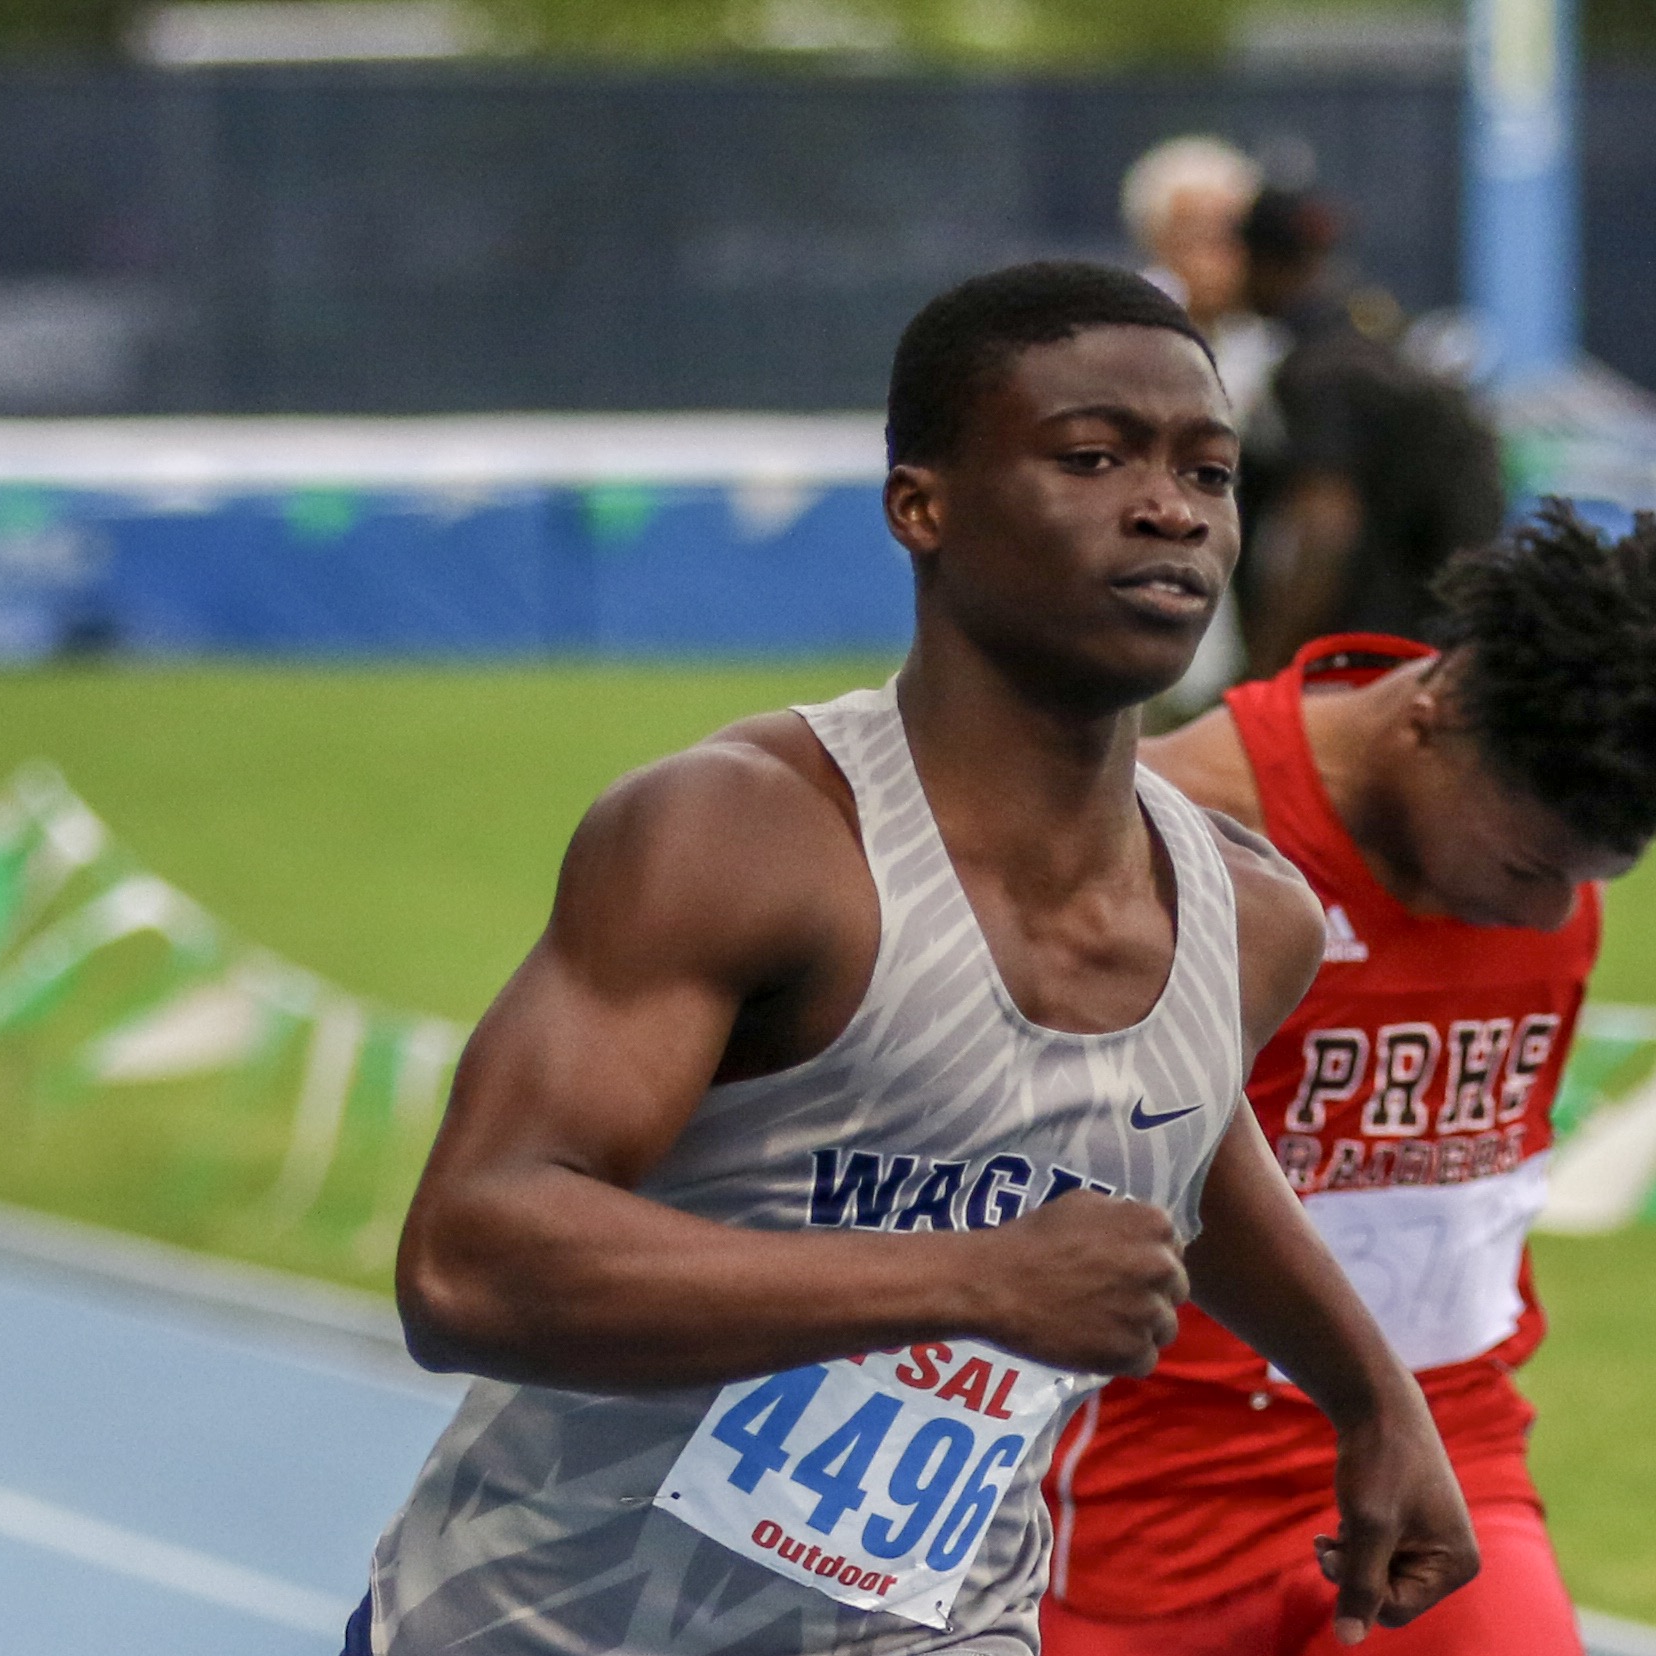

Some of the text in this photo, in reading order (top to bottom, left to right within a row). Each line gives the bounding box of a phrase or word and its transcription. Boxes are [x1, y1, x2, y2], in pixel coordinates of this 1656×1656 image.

[807, 1147, 1136, 1233] WAG
[847, 1340, 1020, 1420] SAL
[711, 1363, 1025, 1573] 4496
[751, 1519, 898, 1597] Outdoor
